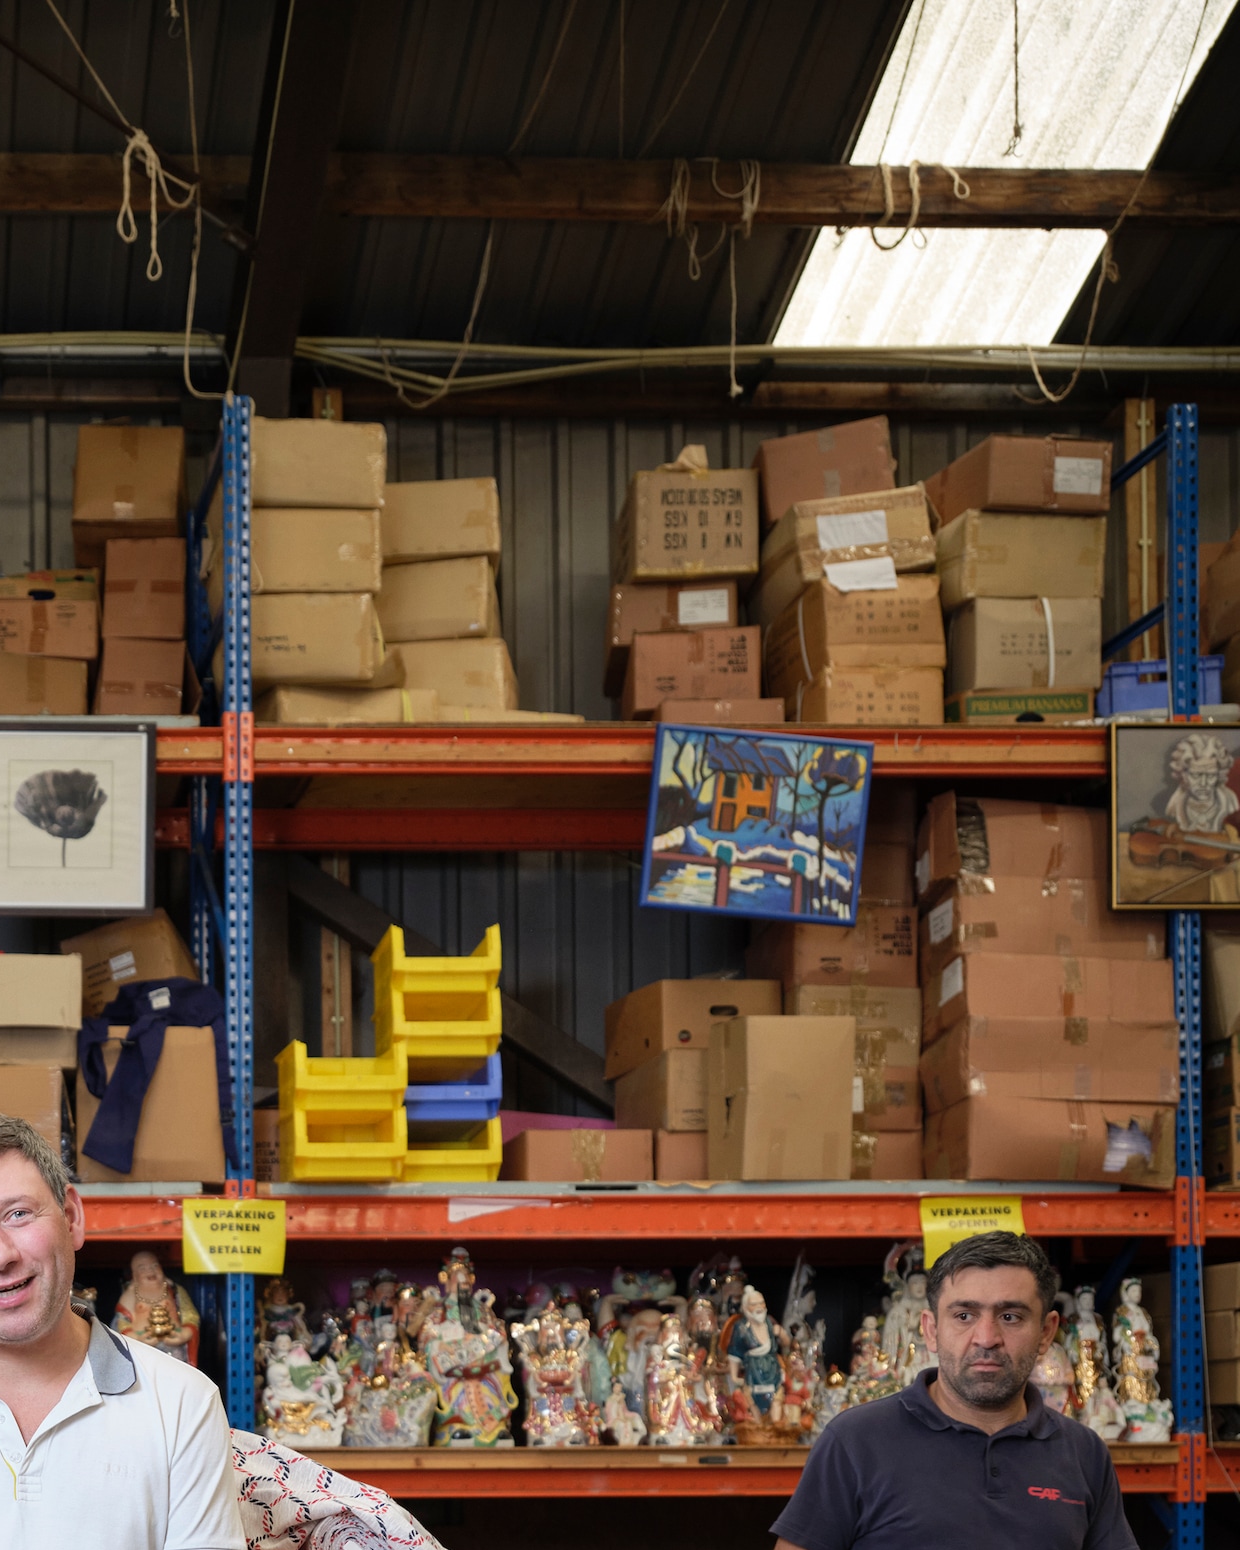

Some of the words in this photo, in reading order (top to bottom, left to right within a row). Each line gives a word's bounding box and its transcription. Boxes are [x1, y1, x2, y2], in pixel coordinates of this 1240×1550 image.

[971, 699, 1026, 712] PREMIUM
[1027, 698, 1084, 711] BANANAS
[194, 1210, 276, 1220] VERPAKKING
[930, 1206, 1012, 1217] VERPAKKING
[210, 1223, 261, 1232] OPENEN
[948, 1218, 999, 1228] OPENEN
[209, 1245, 262, 1255] BETALEN
